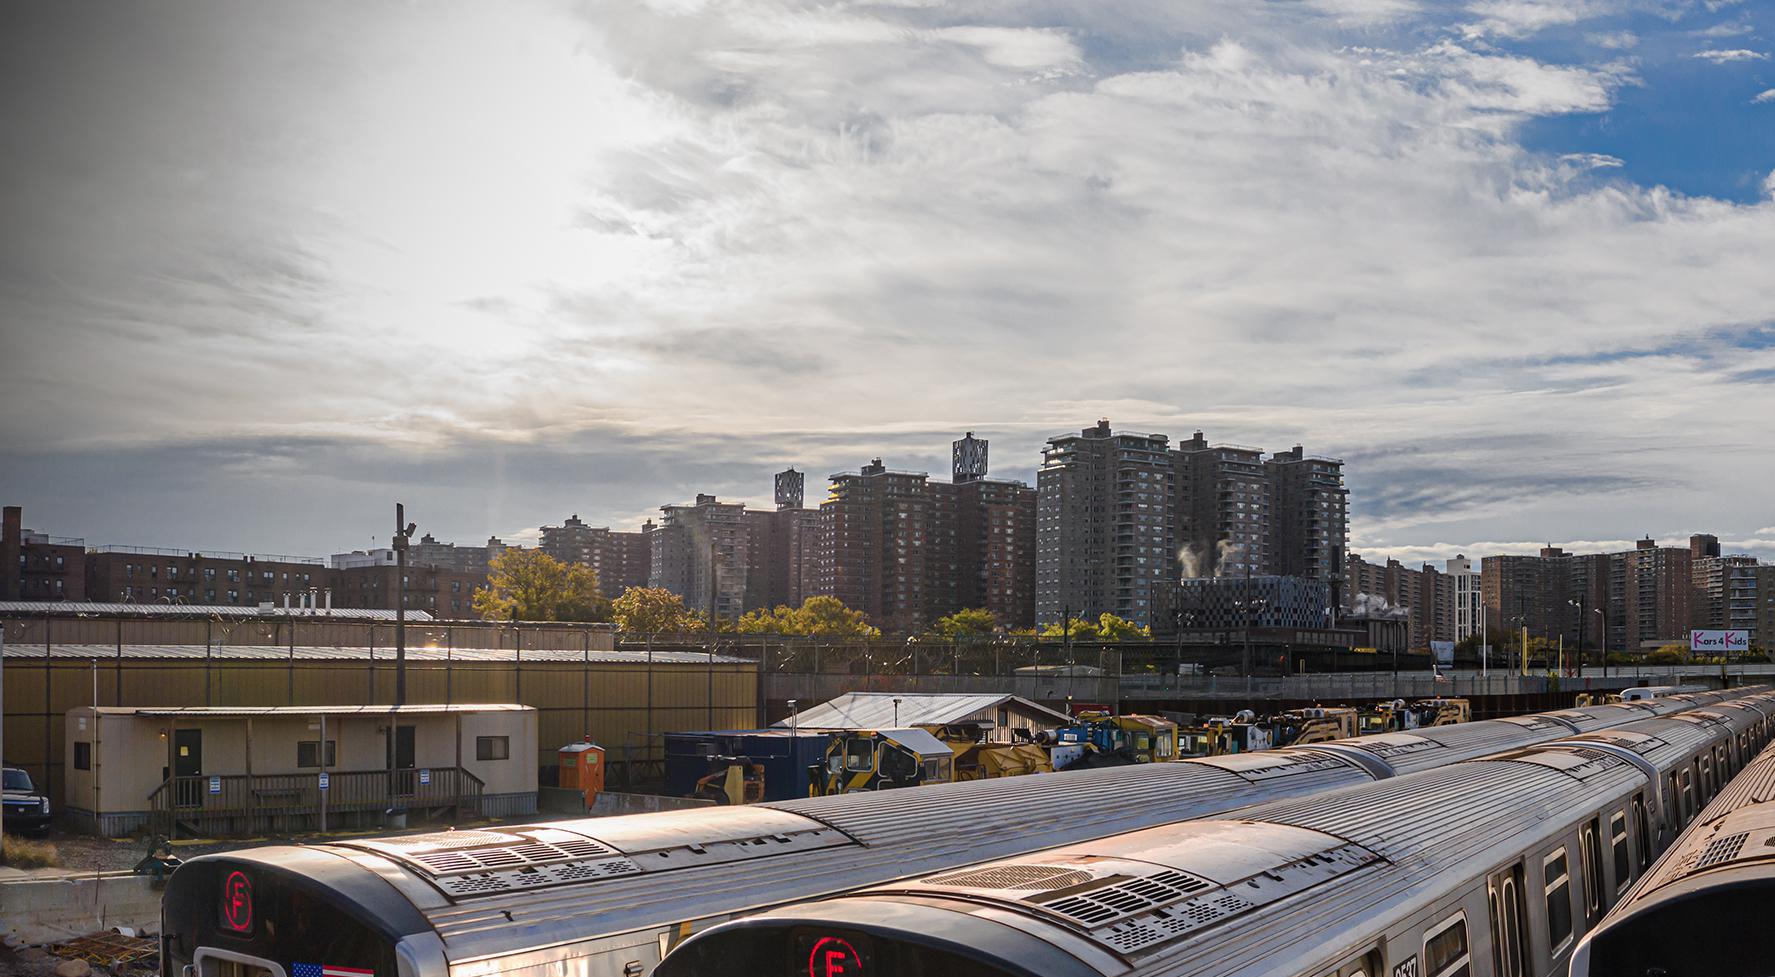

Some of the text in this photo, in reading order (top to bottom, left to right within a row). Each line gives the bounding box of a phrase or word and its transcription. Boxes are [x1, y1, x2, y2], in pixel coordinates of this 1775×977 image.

[1694, 632, 1747, 648] Kars 4 Kids
